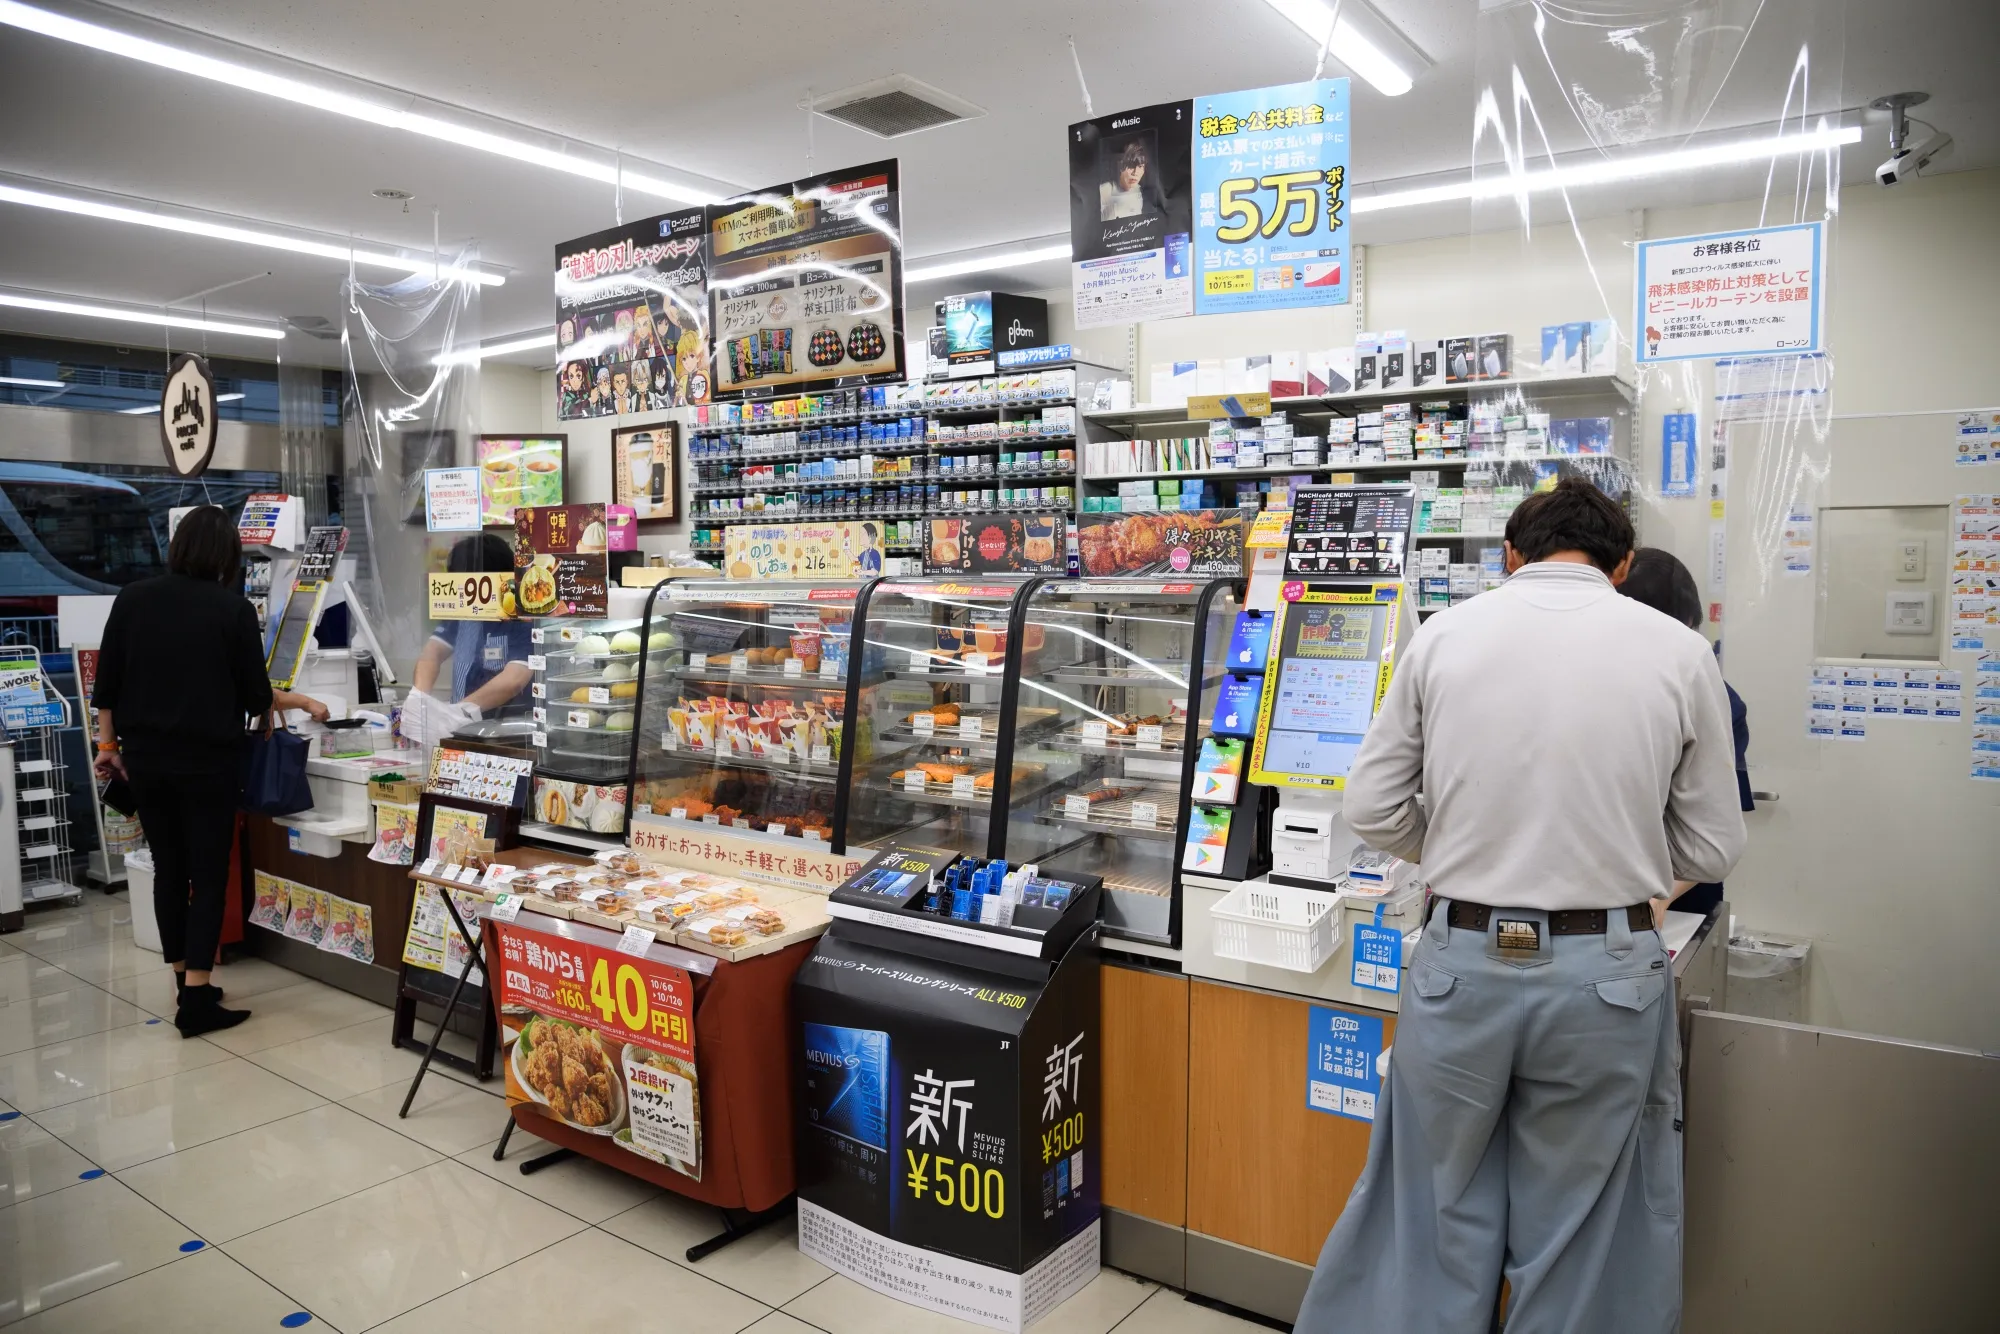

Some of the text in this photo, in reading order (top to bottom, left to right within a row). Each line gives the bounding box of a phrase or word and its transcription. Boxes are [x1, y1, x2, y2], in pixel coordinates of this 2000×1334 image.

[1118, 116, 1140, 127] Music
[1230, 150, 1316, 174] カード提示で
[1216, 170, 1324, 244] 5万
[1326, 166, 1344, 232] ポイント
[1200, 192, 1216, 228] 最高
[672, 214, 702, 228] ローソン銀行
[1693, 239, 1760, 257] お客様各位
[1204, 246, 1264, 268] 当たる!
[1082, 272, 1156, 289] 1か月無料コードプレゼント
[1099, 266, 1138, 278] Apple Music
[804, 284, 844, 300] オリジナル
[1648, 270, 1810, 298] 飛沫感染防止対策として
[724, 299, 758, 314] オリジナル
[804, 295, 857, 317] がま口財布
[1649, 287, 1808, 313] ビニールカーテンを設置
[724, 312, 764, 329] クッション
[1008, 319, 1033, 345] ploom
[550, 514, 566, 529] 中華
[551, 531, 566, 544] まん
[961, 519, 976, 568] とけコロ
[751, 543, 772, 558] のり
[1192, 548, 1237, 560] チキン串
[757, 558, 788, 575] しお味
[559, 573, 575, 583] チーズ
[432, 575, 492, 606] おでん 90
[559, 584, 603, 595] キーマカレーまん
[4, 673, 40, 688] WORK
[28, 715, 63, 724] お持ち下さい
[1202, 752, 1238, 762] Google Play
[1192, 822, 1226, 832] Google Play
[878, 852, 930, 872] 新 ¥500
[502, 935, 523, 950] 今なら
[504, 949, 522, 962] お得!
[525, 940, 585, 983] 鶏から 各種
[1365, 954, 1388, 964] 取扱店舗
[508, 973, 530, 992] 4個入
[812, 955, 1026, 1009] MEVIUS スーパースリムロングシリーズ ALL ¥500
[590, 958, 648, 1031] 40
[651, 1009, 688, 1044] 円引
[1000, 1040, 1010, 1050] JT
[1333, 1032, 1356, 1042] トラベル
[807, 1049, 842, 1068] MEVIUS
[1324, 1044, 1364, 1058] 地域共通
[1324, 1052, 1364, 1067] クーポン
[1042, 1031, 1084, 1123] 新
[1324, 1062, 1364, 1079] 取扱店舗
[630, 1067, 675, 1092] 2度揚げで
[633, 1105, 689, 1134] 中はジューシー!
[906, 1069, 975, 1154] 新
[974, 1131, 1006, 1146] MEVIUS
[1042, 1112, 1083, 1164] ¥500
[973, 1141, 1004, 1155] SUPER
[972, 1150, 1004, 1165] SLIMS
[907, 1149, 1005, 1219] ¥500
